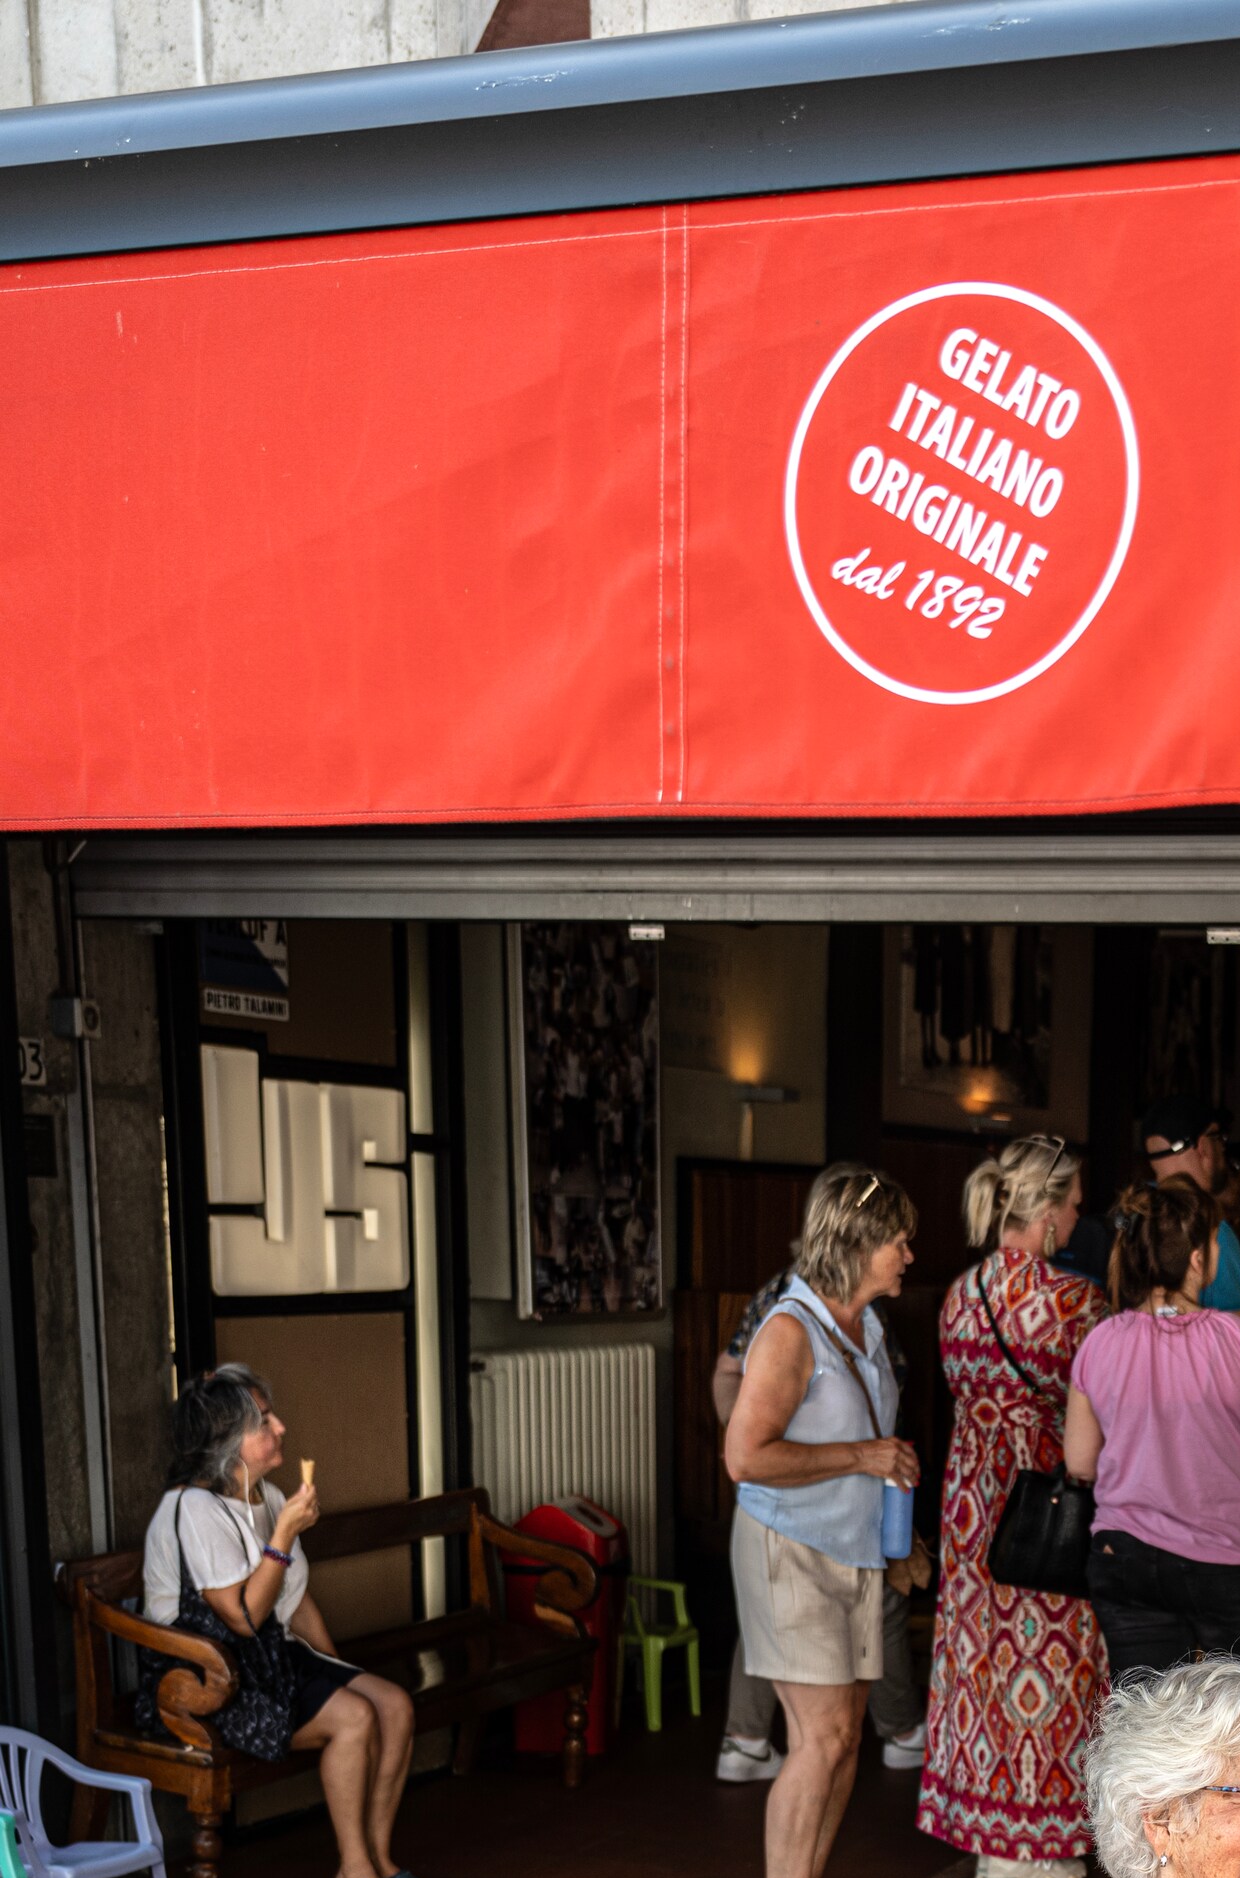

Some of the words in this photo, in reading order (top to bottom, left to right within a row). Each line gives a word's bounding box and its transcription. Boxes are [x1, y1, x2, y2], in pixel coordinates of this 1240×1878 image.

[939, 327, 1081, 440] GELATO
[888, 381, 1064, 519] ITALIANO
[847, 445, 1050, 598] ORIGINALE
[830, 547, 906, 601] dal
[904, 569, 1006, 640] 1892
[206, 991, 241, 1010] PIETRO
